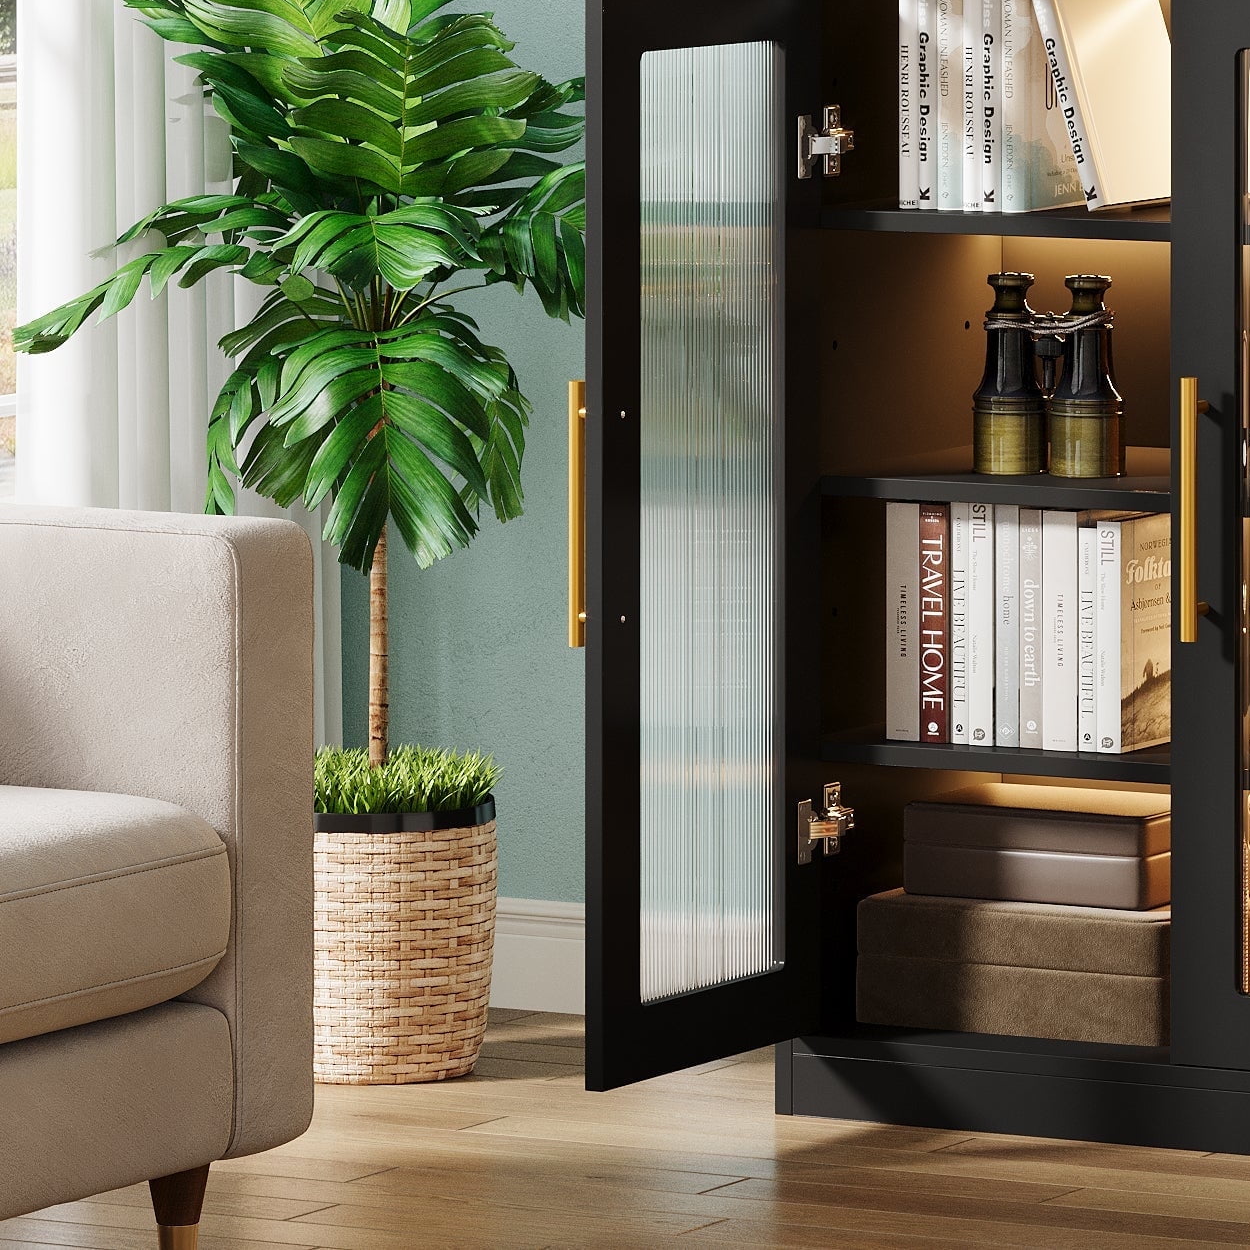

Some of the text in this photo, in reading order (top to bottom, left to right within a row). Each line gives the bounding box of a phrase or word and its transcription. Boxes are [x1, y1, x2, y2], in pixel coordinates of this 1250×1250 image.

[918, 32, 930, 98] Graphic
[940, 38, 949, 97] UNLEASHED
[983, 33, 994, 101] Graphic
[1004, 40, 1013, 99] UNLEASHED
[901, 45, 910, 158] HENRI ROUSSEAU
[965, 47, 974, 160] HENRI ROUSSEAU
[1045, 38, 1069, 103] Graphic
[1063, 106, 1085, 164] Design
[919, 105, 931, 162] Design
[983, 107, 995, 164] Design
[919, 187, 930, 201] K
[983, 189, 995, 203] K
[1054, 182, 1077, 198] JENN
[1084, 185, 1098, 202] K
[972, 504, 986, 542] STILL
[1100, 530, 1115, 566] STILL
[922, 534, 943, 623] TRAVEL
[953, 570, 966, 708] LIVE BEAUTIFUL
[1003, 595, 1014, 626] home
[1023, 579, 1041, 687] down to earth
[922, 630, 944, 710] HOME
[1081, 590, 1094, 719] LIVE BEAUTIFUL
